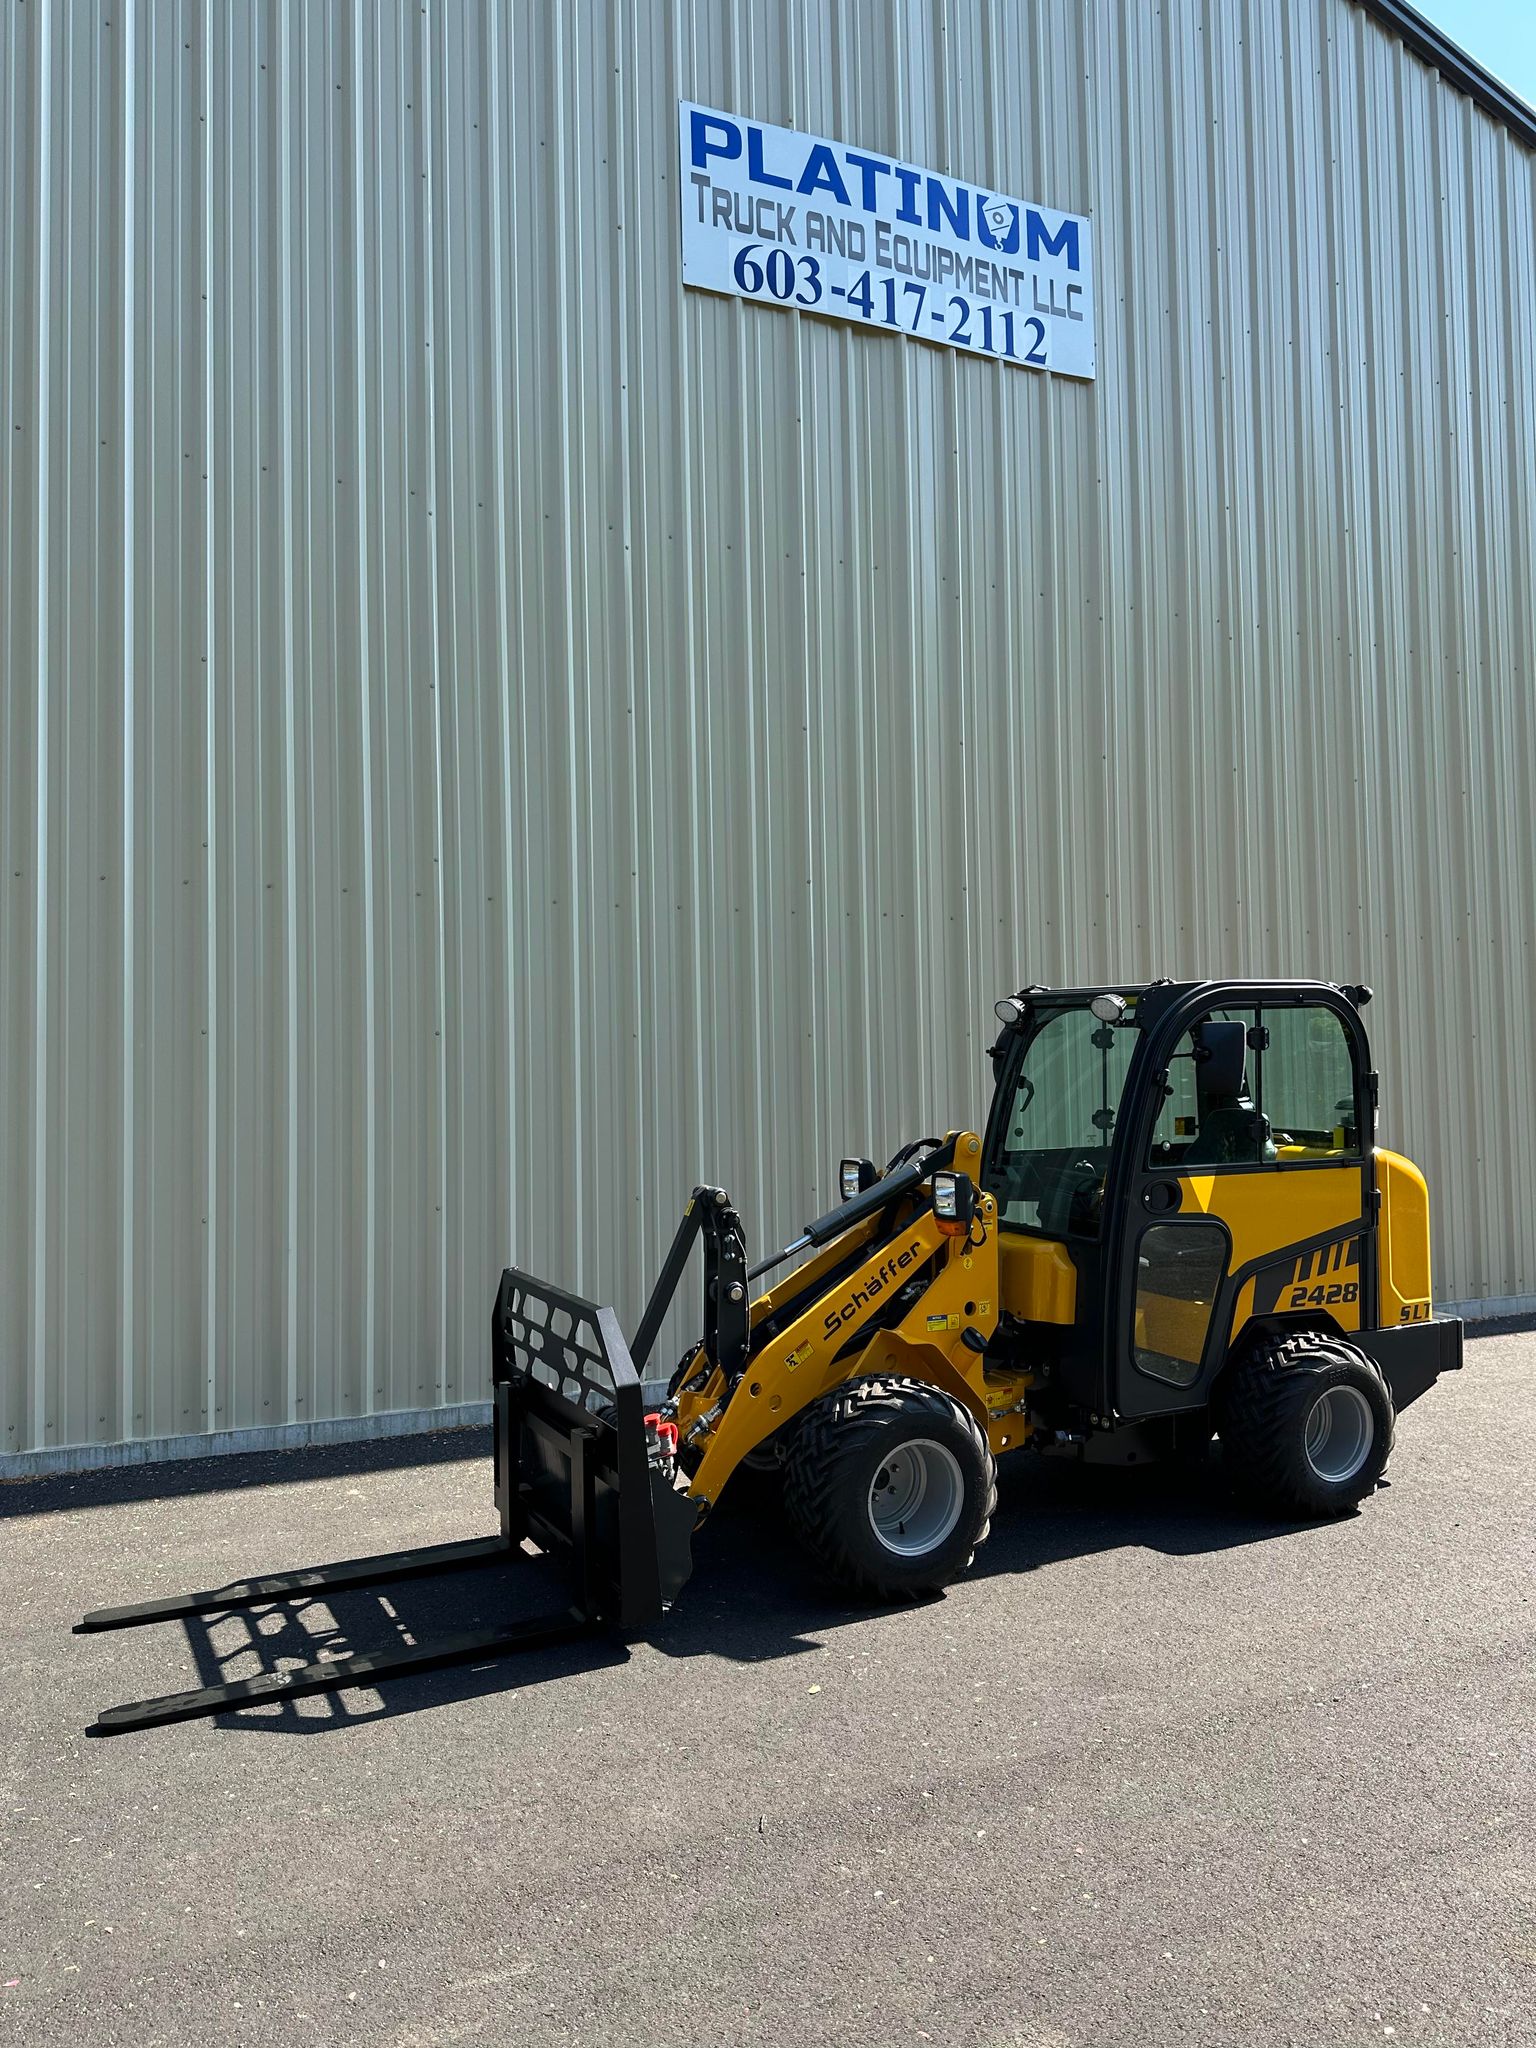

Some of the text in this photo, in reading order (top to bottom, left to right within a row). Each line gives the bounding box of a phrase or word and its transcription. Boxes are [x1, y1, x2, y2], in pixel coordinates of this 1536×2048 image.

[690, 110, 1080, 272] PLATINUM
[733, 244, 1048, 365] 603-417-2112
[806, 210, 866, 263] AND
[1032, 274, 1083, 322] LLC
[823, 1241, 921, 1342] Schäffer
[1290, 1282, 1359, 1308] 2428
[1399, 1302, 1431, 1322] SLT
